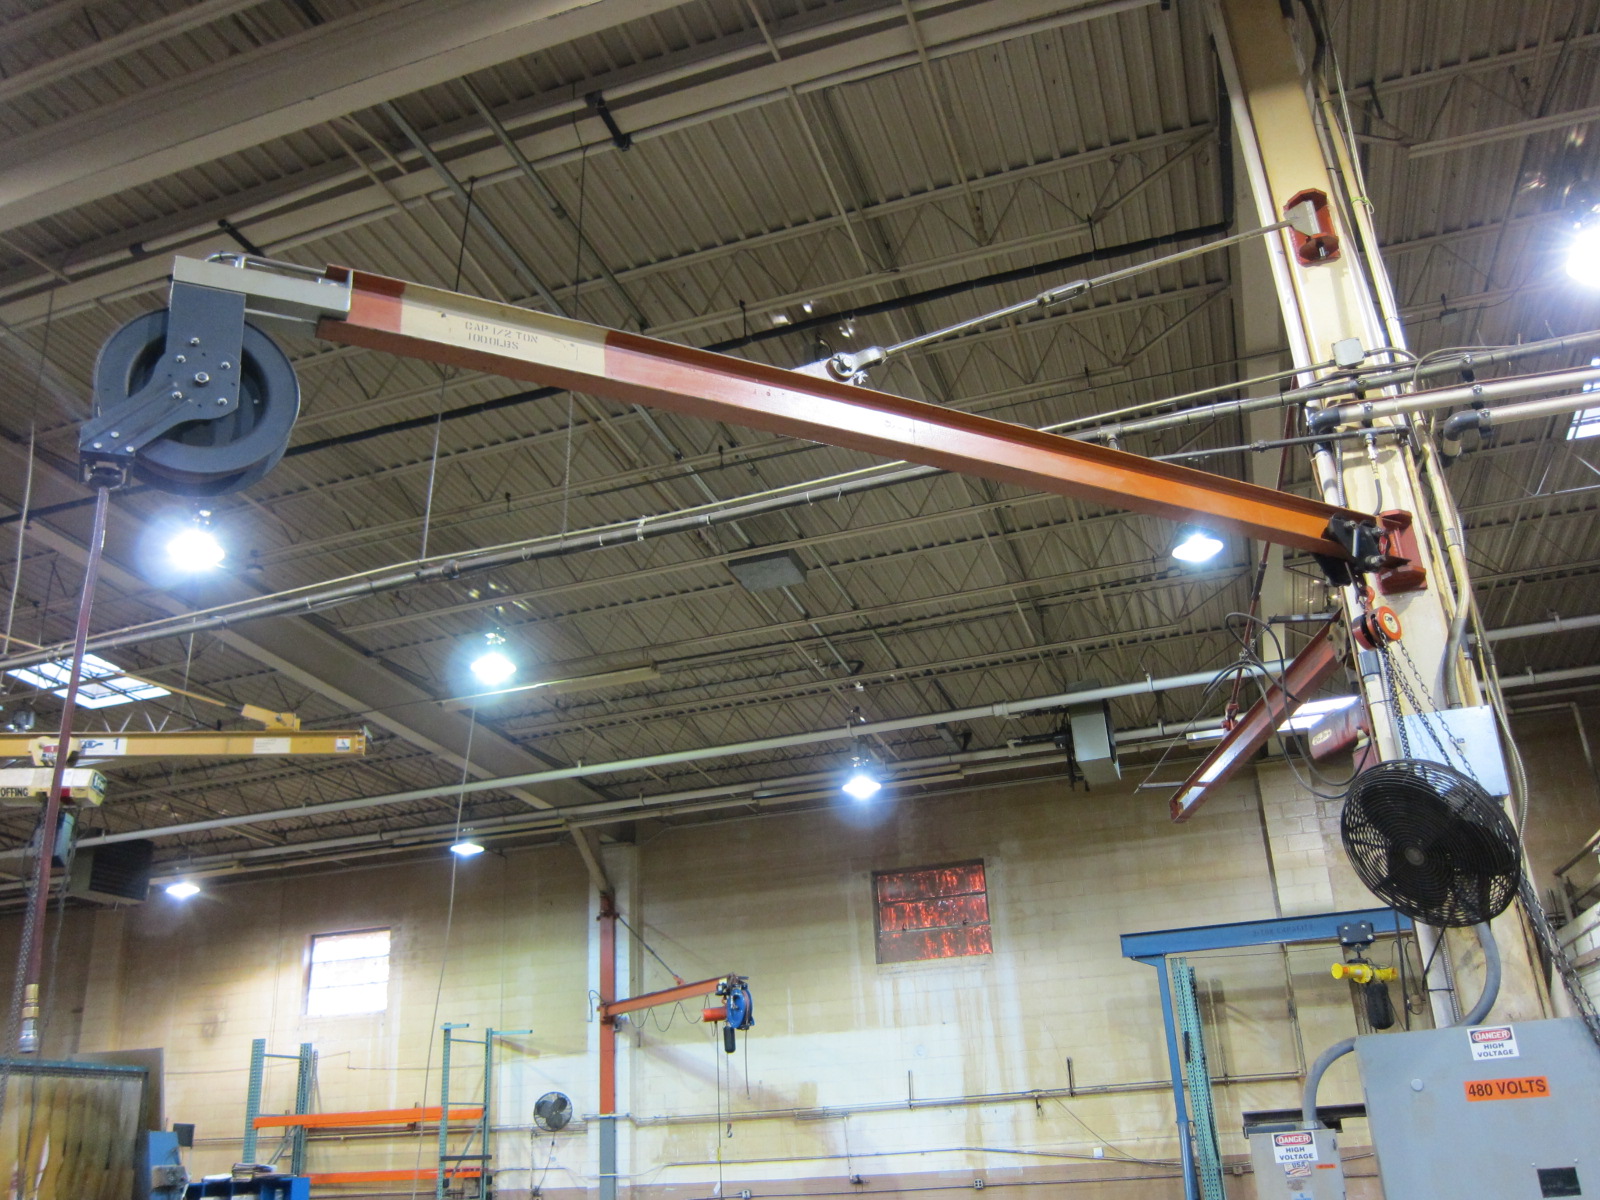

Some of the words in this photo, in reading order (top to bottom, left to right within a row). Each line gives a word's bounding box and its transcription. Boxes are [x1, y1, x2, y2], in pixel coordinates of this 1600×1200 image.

[465, 321, 488, 332] CAP
[493, 327, 512, 339] 1/2
[516, 332, 538, 344] TON
[1475, 1030, 1507, 1040] DANGER
[1477, 1049, 1514, 1057] VOLTAGE
[1468, 1083, 1493, 1096] 480
[1496, 1079, 1546, 1095] VOLTS
[1278, 1135, 1309, 1143] DANGER
